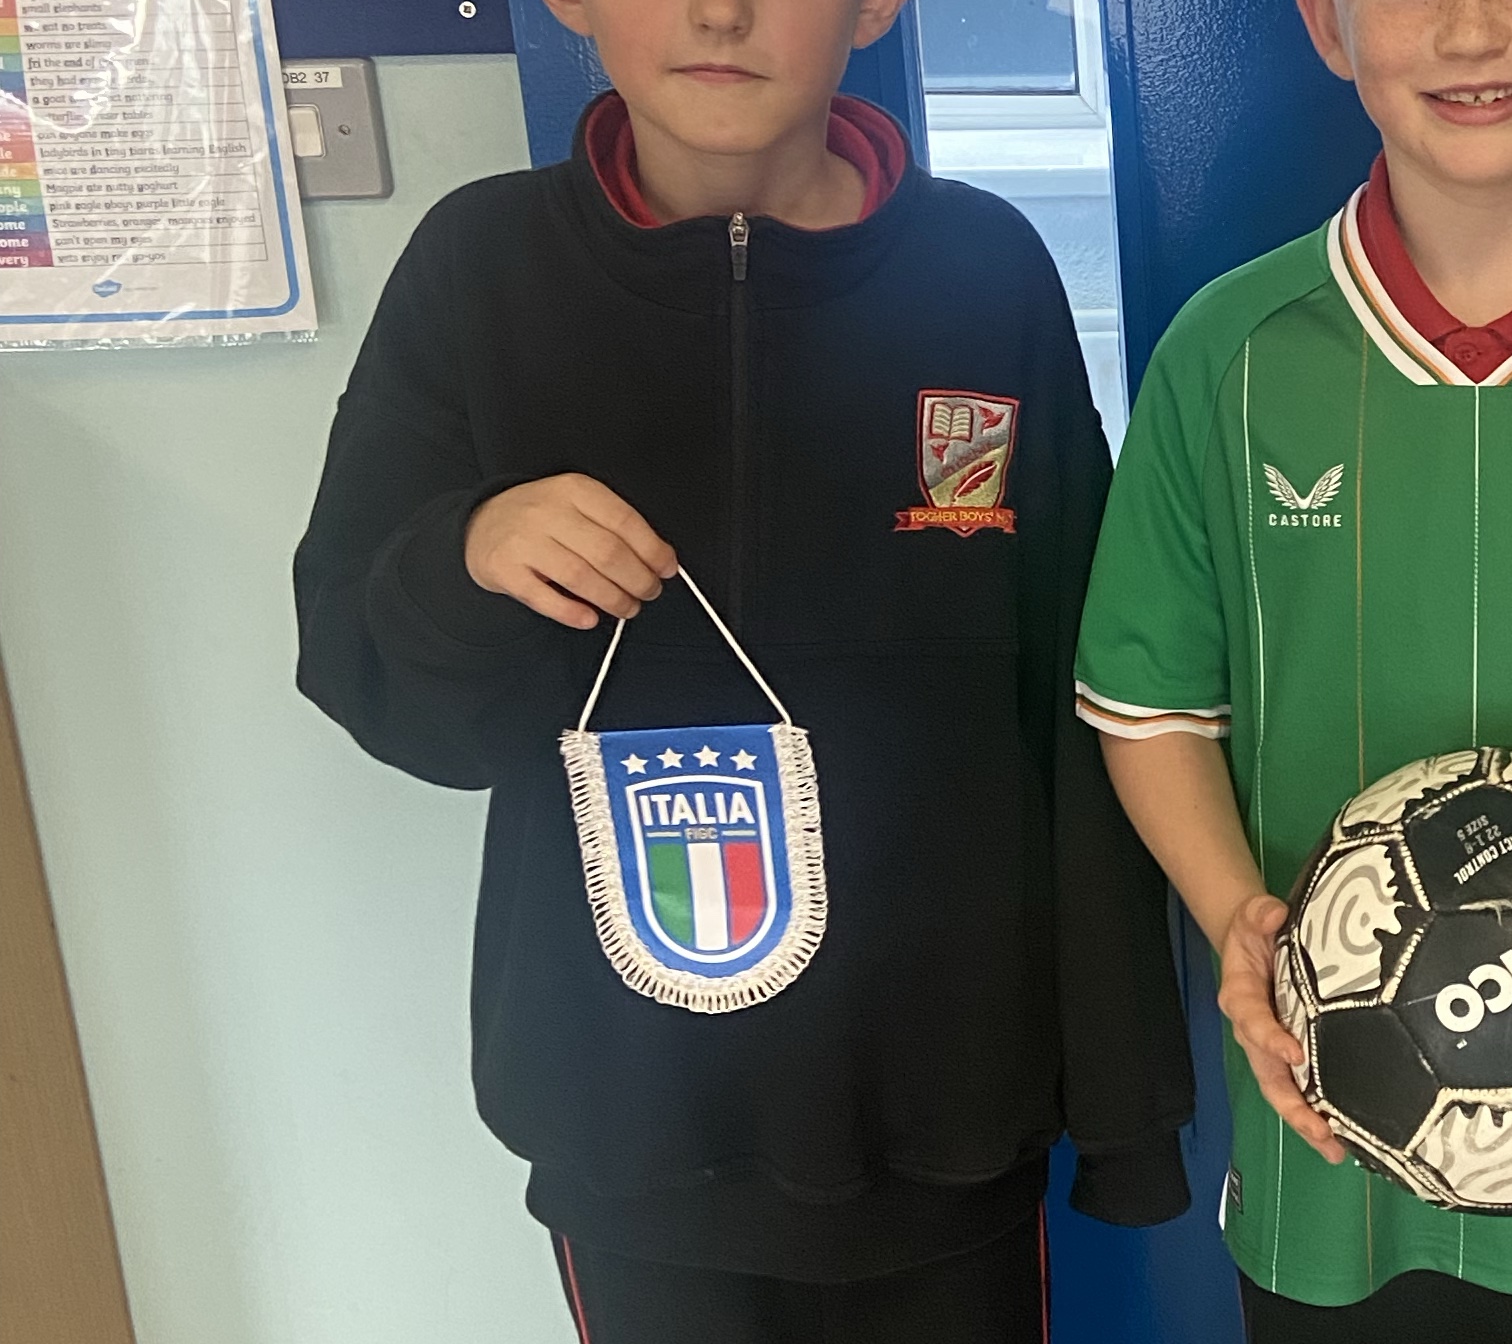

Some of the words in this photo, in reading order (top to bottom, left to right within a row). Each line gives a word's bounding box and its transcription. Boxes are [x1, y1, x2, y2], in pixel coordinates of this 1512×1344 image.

[314, 71, 330, 84] 37
[1268, 513, 1342, 527] CASTORE
[638, 791, 756, 826] ITALIA
[1464, 814, 1490, 837] SIZE
[1456, 828, 1466, 842] 5
[1453, 845, 1499, 885] CONTROL
